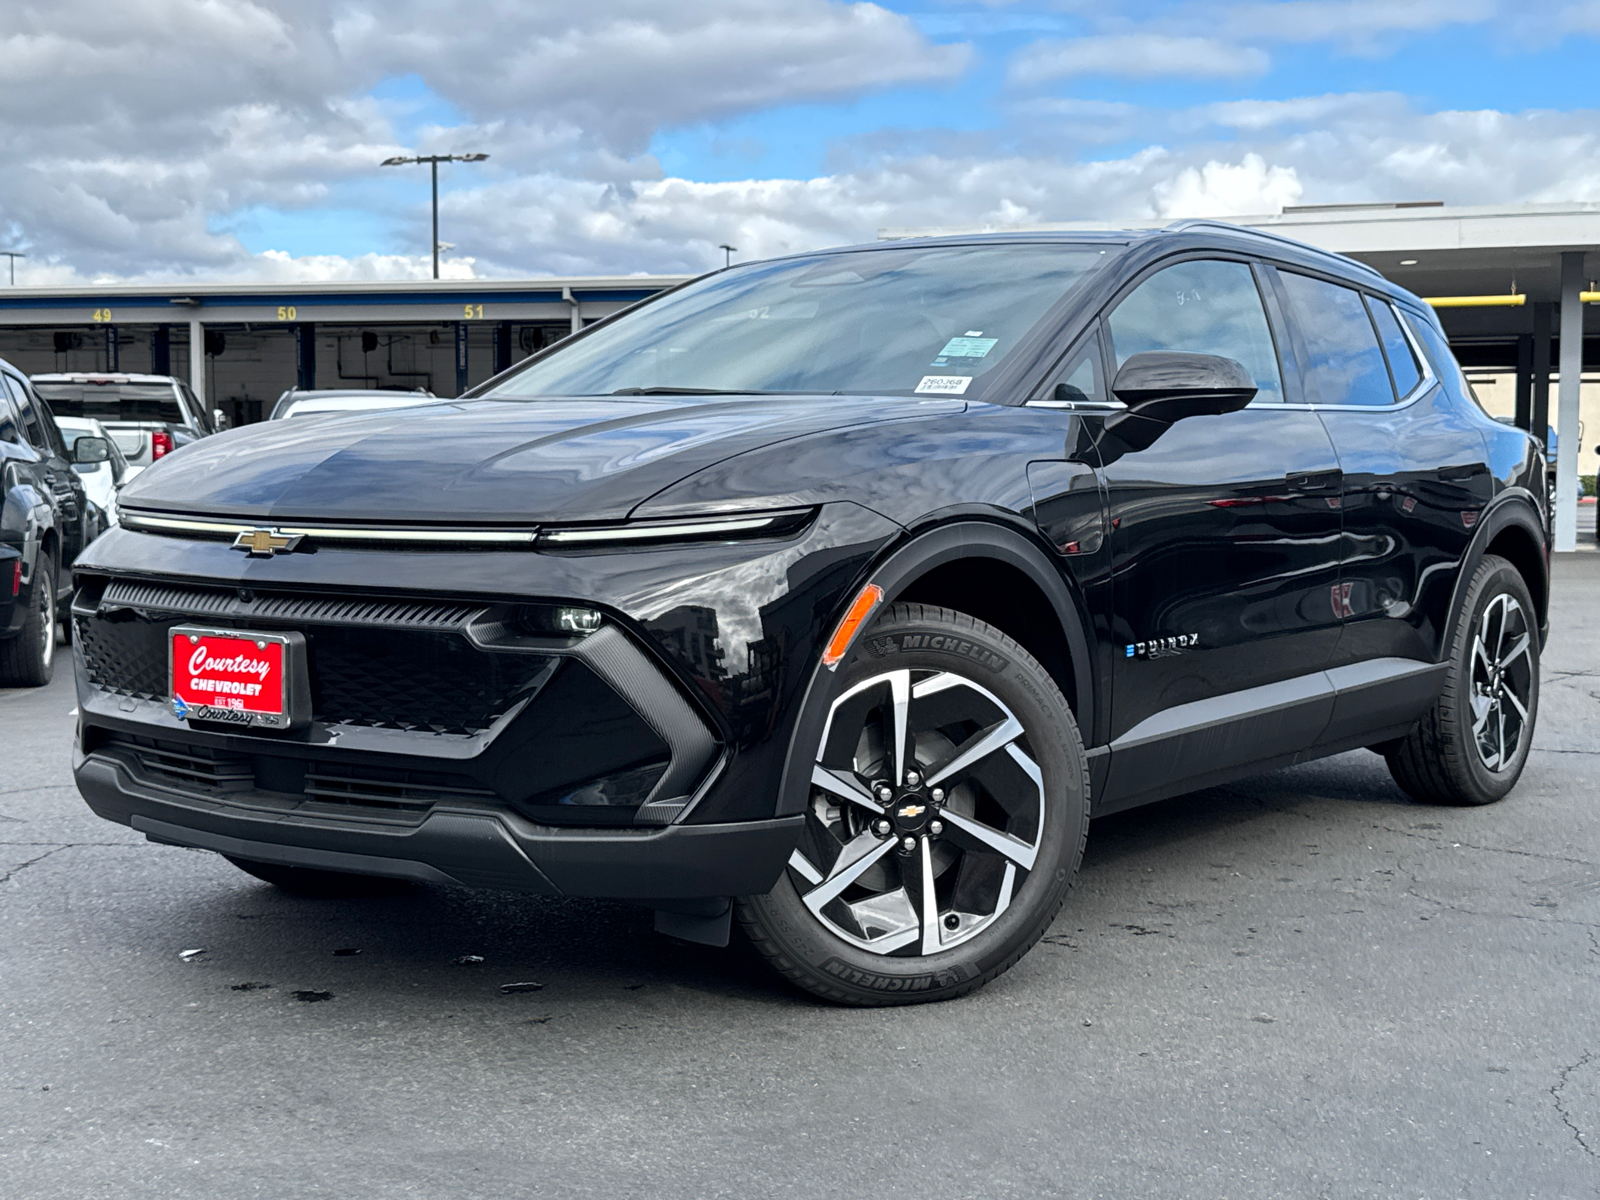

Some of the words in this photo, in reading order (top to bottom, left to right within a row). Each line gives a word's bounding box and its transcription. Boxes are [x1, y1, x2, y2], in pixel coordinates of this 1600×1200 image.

[92, 308, 112, 322] 49
[277, 306, 297, 321] 50
[464, 304, 484, 319] 51
[902, 635, 1004, 670] MICHELIN
[1125, 632, 1199, 658] EQUINOX
[188, 645, 271, 682] Courtesy
[190, 677, 263, 697] CHEVROLET
[1015, 673, 1056, 720] PRIMACY
[197, 704, 255, 728] Courtesy
[227, 698, 244, 710] 1961
[825, 963, 933, 991] MICHELIN
